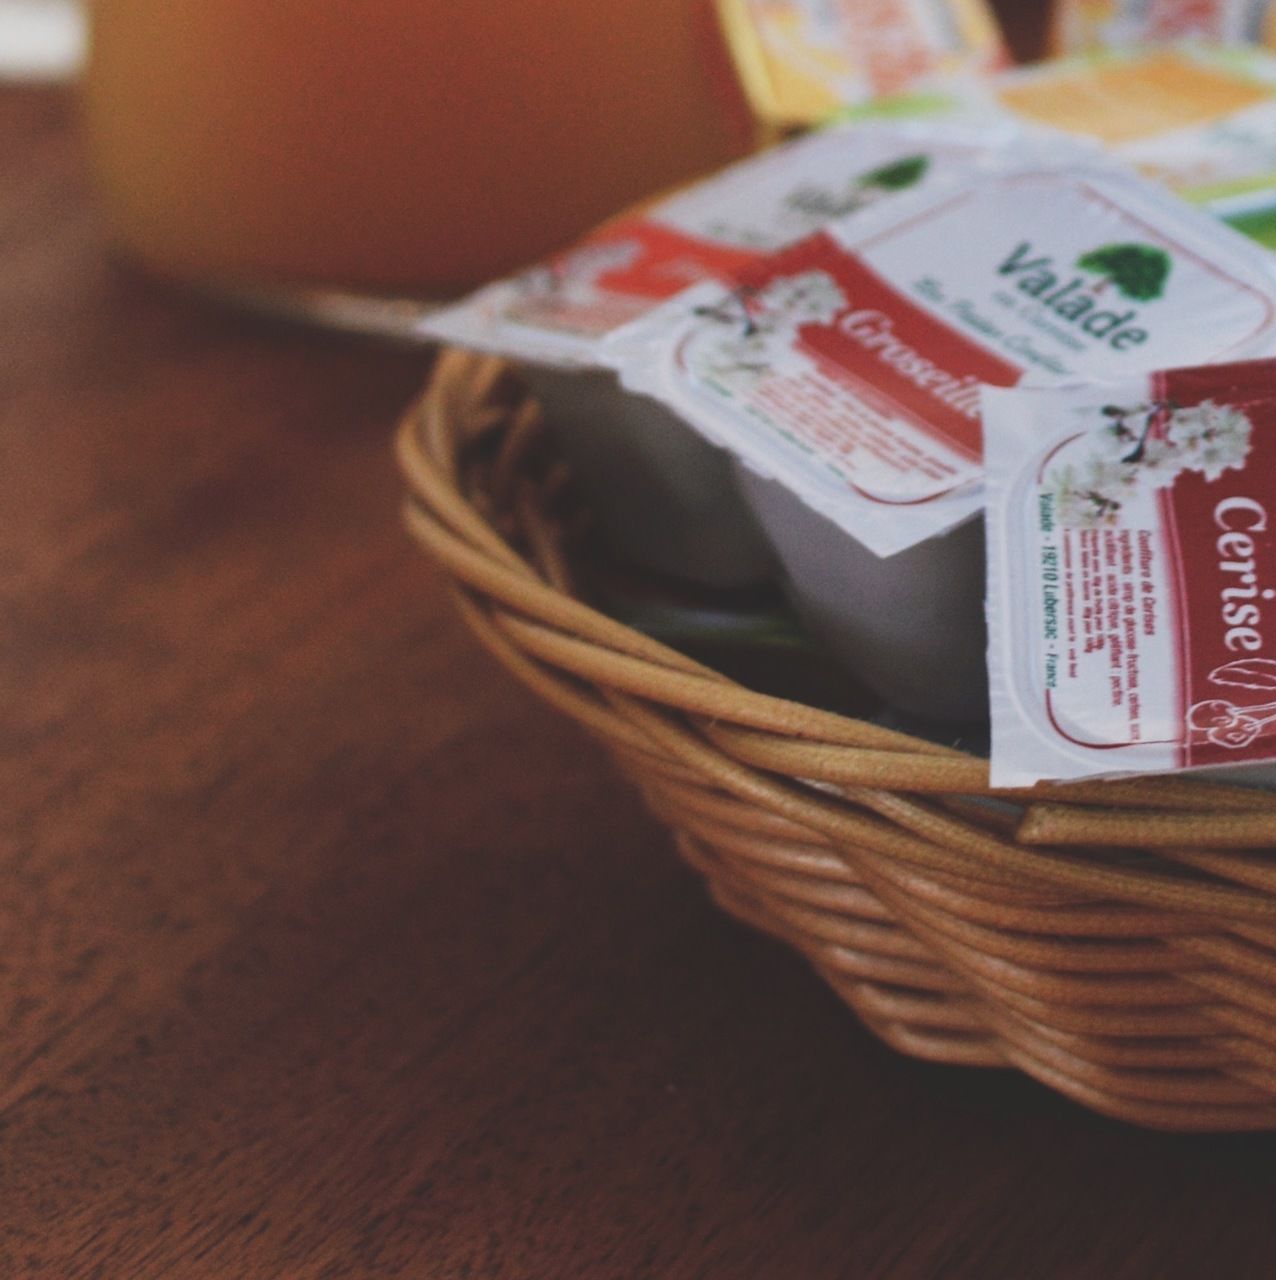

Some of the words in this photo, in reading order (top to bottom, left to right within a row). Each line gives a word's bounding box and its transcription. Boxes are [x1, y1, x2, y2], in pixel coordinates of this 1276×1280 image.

[997, 242, 1148, 350] Valade
[1040, 494, 1055, 531] Valade
[1041, 545, 1057, 580] 19210
[1137, 529, 1154, 578] Confiture
[1140, 580, 1154, 593] de
[1214, 496, 1276, 651] Cerise
[1040, 584, 1060, 639] Lubersac
[1142, 596, 1157, 635] Cerises
[1043, 653, 1059, 687] France
